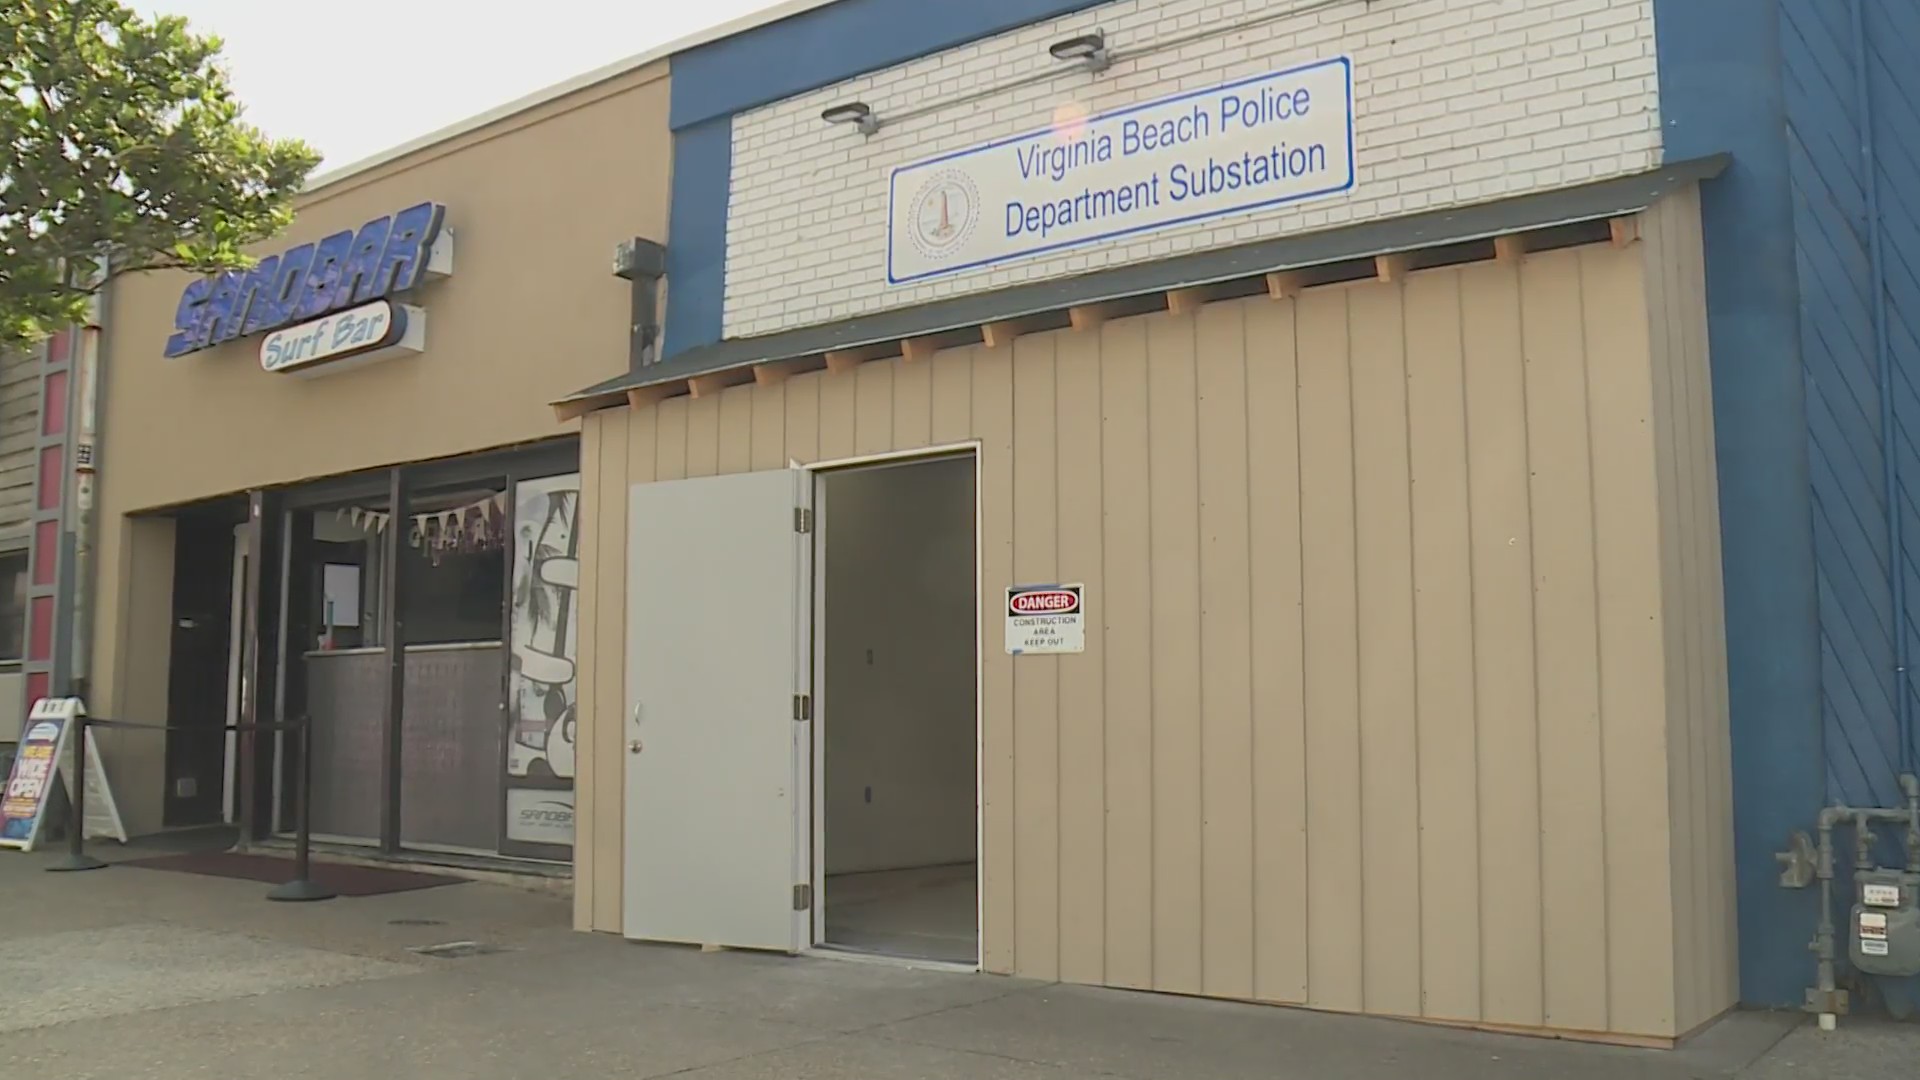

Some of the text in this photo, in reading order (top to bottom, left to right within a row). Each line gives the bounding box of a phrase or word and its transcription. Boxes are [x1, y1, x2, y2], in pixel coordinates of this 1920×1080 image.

[1017, 86, 1310, 182] Virginia Beach Police
[1006, 172, 1160, 238] Department
[1169, 141, 1325, 201] Substation
[164, 202, 438, 358] SANDBAR
[264, 309, 384, 369] Surf Bar
[1018, 595, 1069, 610] DANGER
[1013, 616, 1077, 627] CONSTRUCTION
[1033, 627, 1055, 635] AREA
[1024, 637, 1064, 646] KEEP OUT
